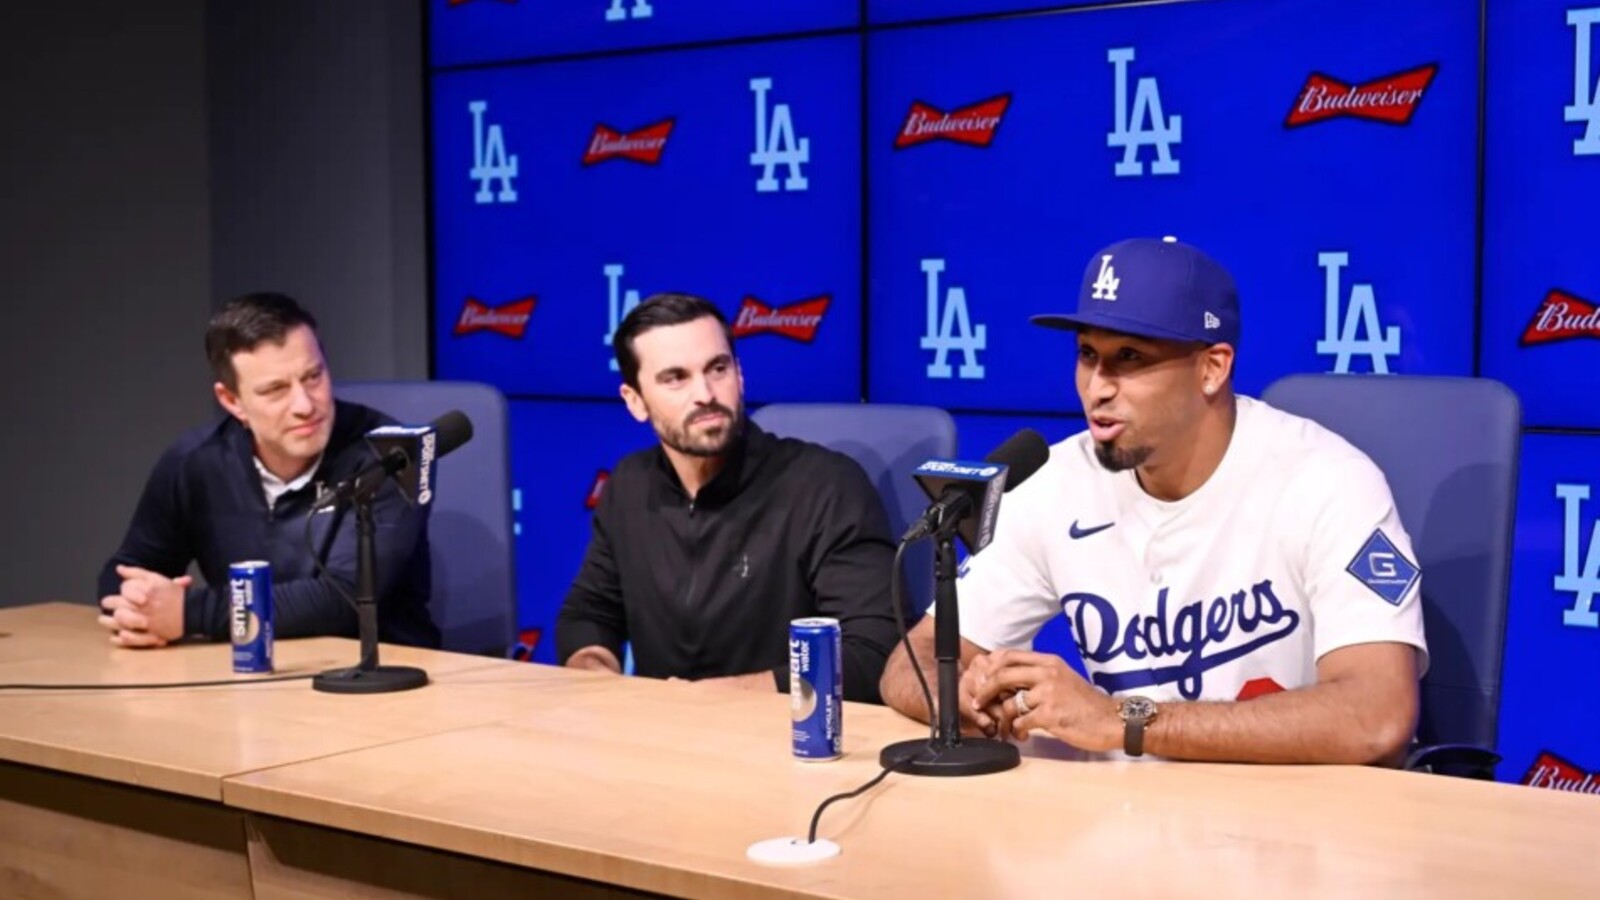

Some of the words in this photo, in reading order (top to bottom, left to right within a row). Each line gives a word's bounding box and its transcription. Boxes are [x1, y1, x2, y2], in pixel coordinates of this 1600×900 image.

[903, 110, 1001, 136] Budweiser
[1107, 47, 1182, 176] LA
[1298, 84, 1423, 113] Budweiser
[469, 101, 518, 203] LA
[588, 132, 667, 154] Budweiser
[750, 77, 809, 192] LA
[1091, 254, 1120, 301] LA
[736, 305, 823, 328] Budweiser
[920, 258, 987, 379] LA
[1316, 251, 1401, 375] LA
[1369, 552, 1398, 577] G
[231, 579, 246, 637] smart
[801, 641, 810, 672] water
[1060, 579, 1299, 700] Dodgers
[790, 639, 801, 711] smart
